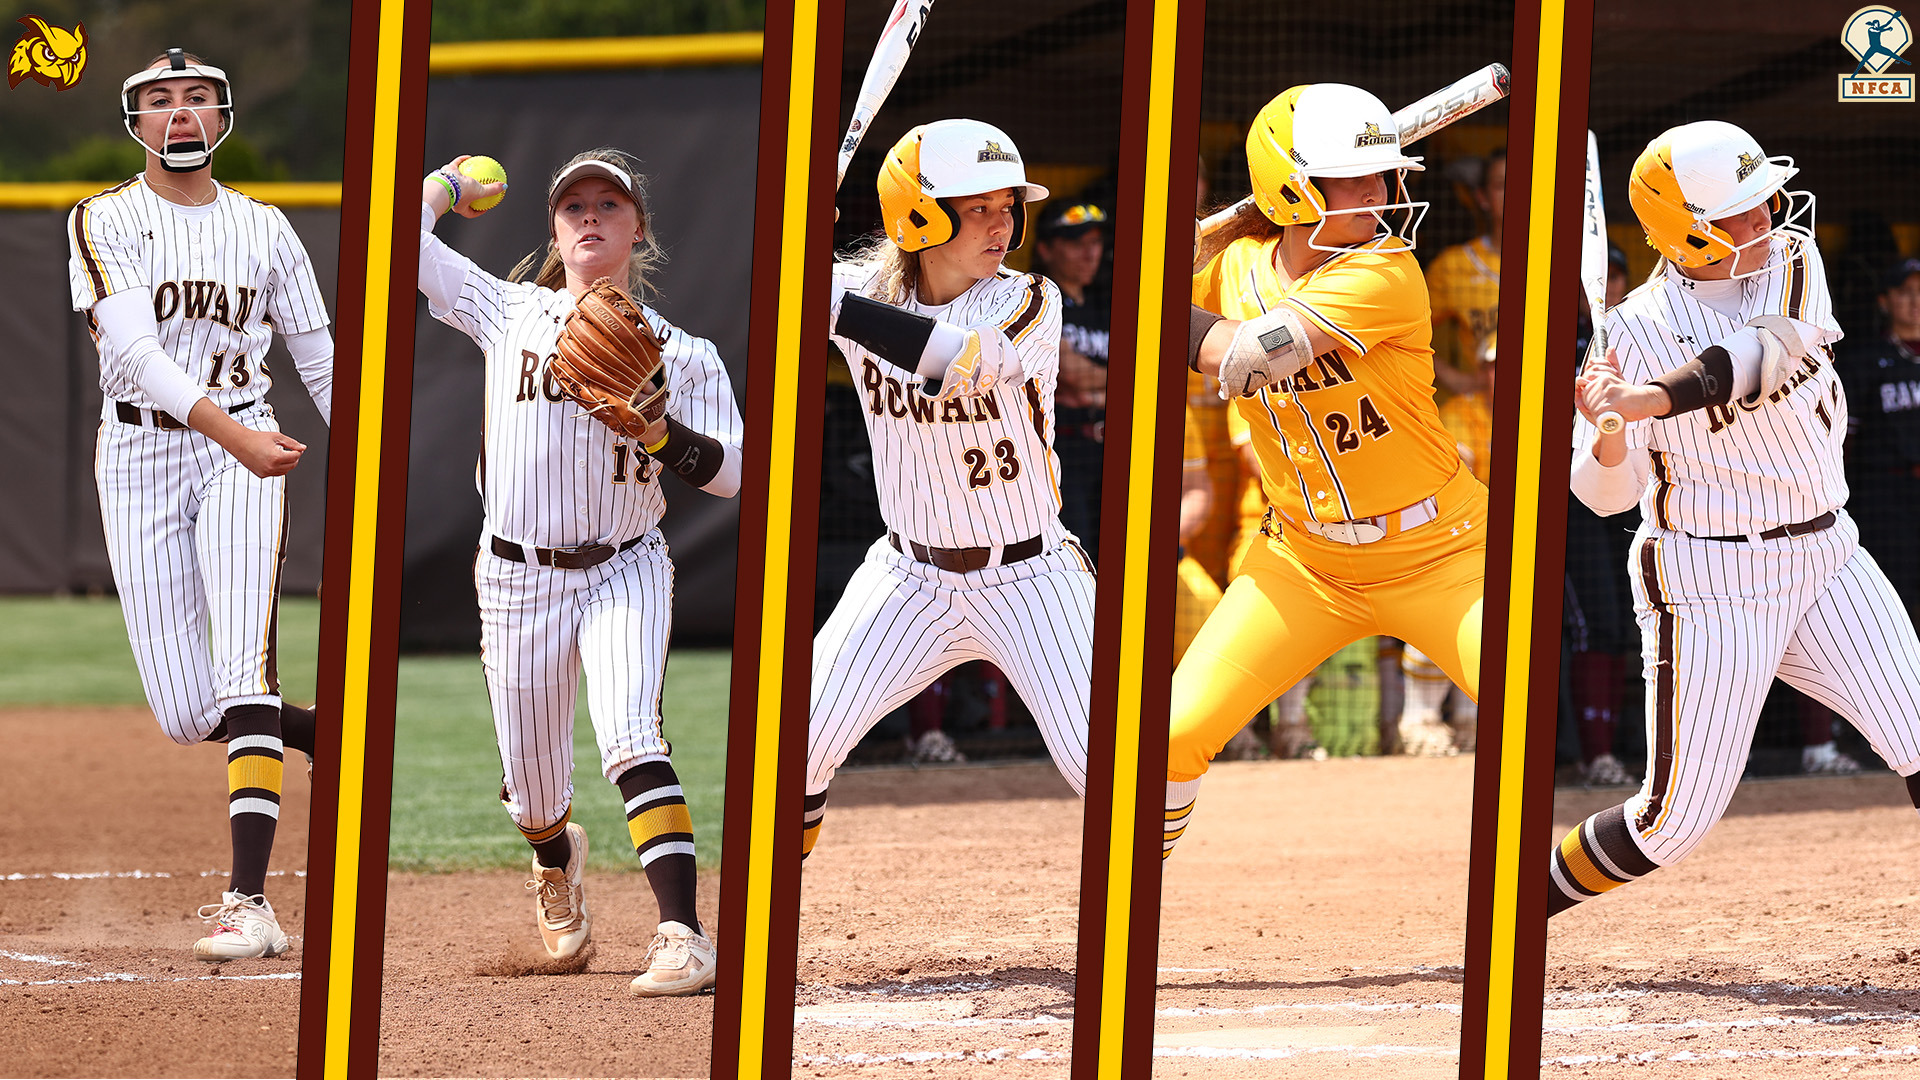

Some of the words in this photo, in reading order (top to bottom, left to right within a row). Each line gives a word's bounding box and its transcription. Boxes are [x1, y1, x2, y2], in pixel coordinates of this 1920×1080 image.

[1399, 81, 1488, 141] HOST
[1289, 147, 1308, 167] schutt
[917, 172, 935, 191] schutt
[1683, 201, 1706, 215] schutt
[153, 280, 258, 336] OWAN
[590, 304, 620, 330] A2000
[206, 350, 252, 389] 13
[862, 355, 1004, 425] ROWAN
[1323, 394, 1393, 455] 24
[611, 442, 652, 485] 18
[961, 437, 1022, 491] 23
